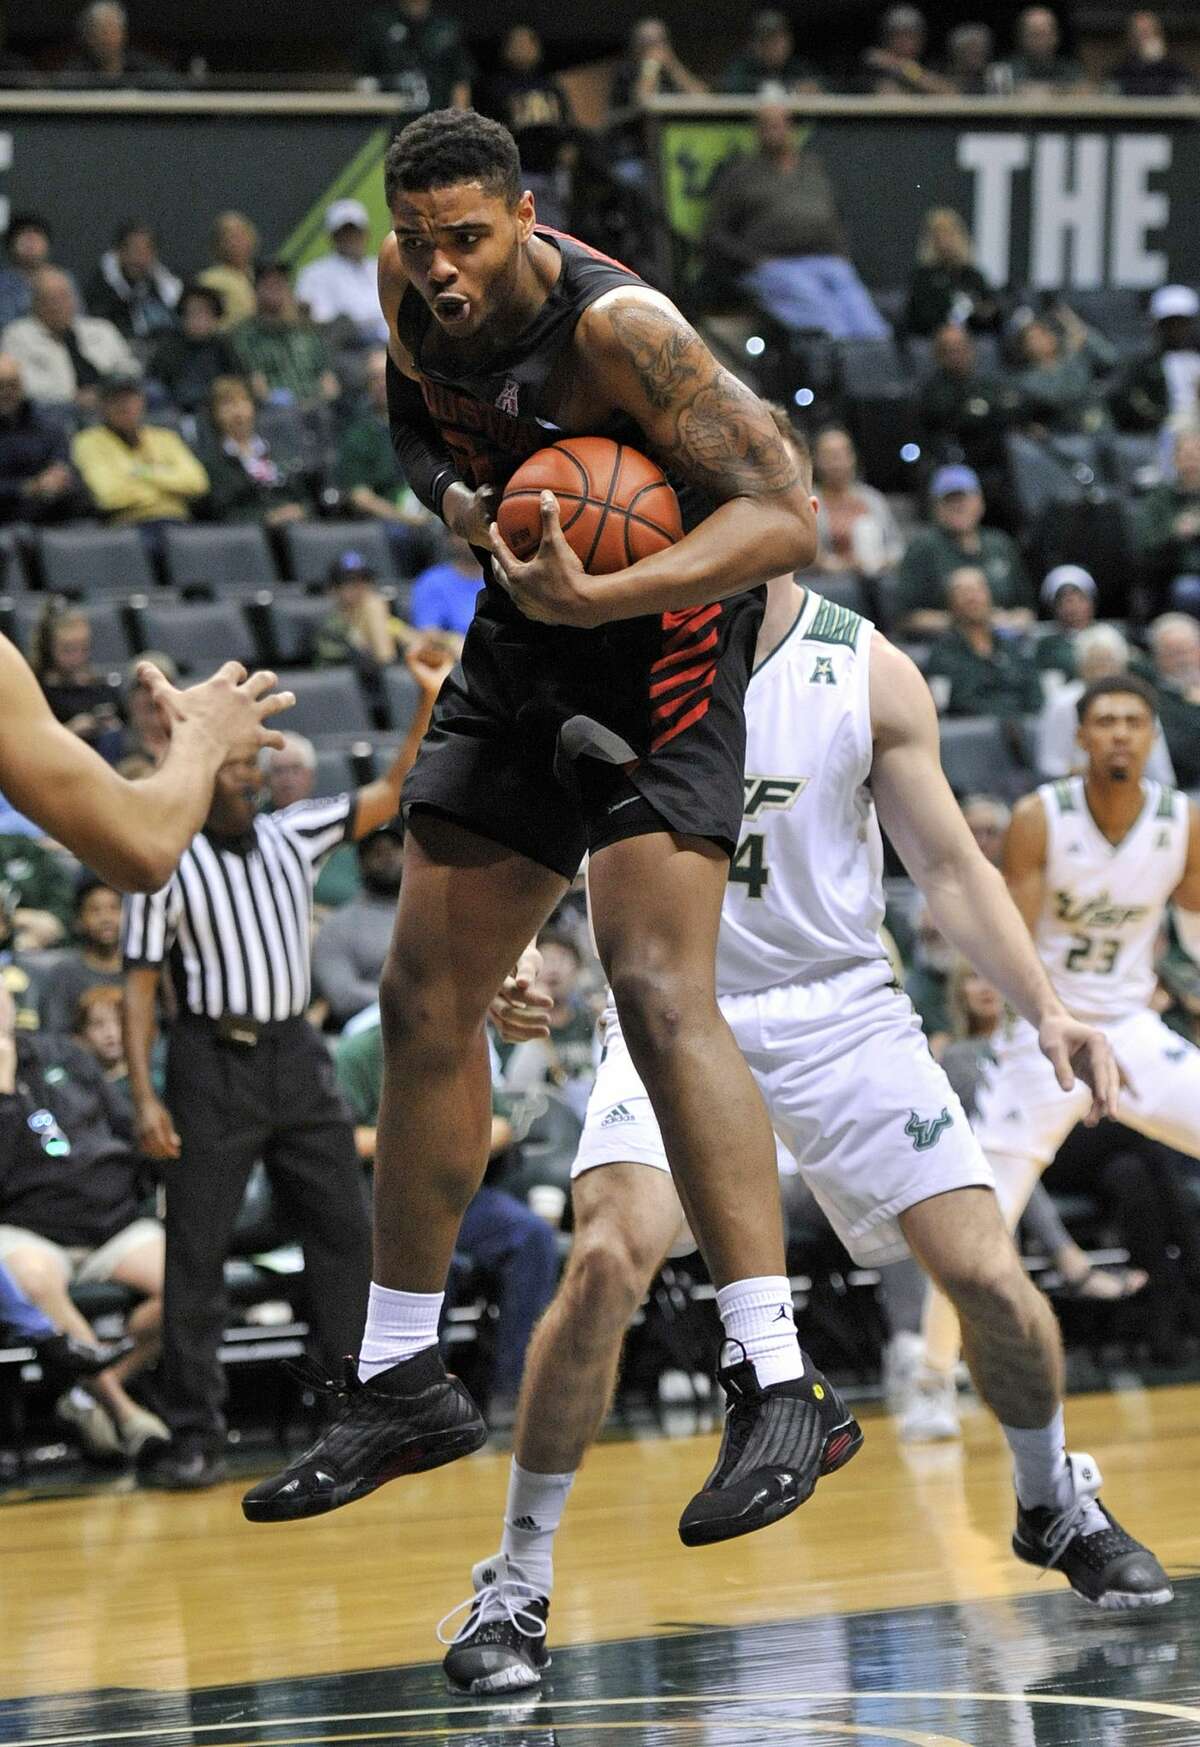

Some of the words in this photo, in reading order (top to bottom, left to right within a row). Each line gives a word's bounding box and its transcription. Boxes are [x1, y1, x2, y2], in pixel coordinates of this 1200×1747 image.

[957, 132, 1173, 289] THE
[809, 656, 837, 685] A
[1066, 933, 1120, 973] 23
